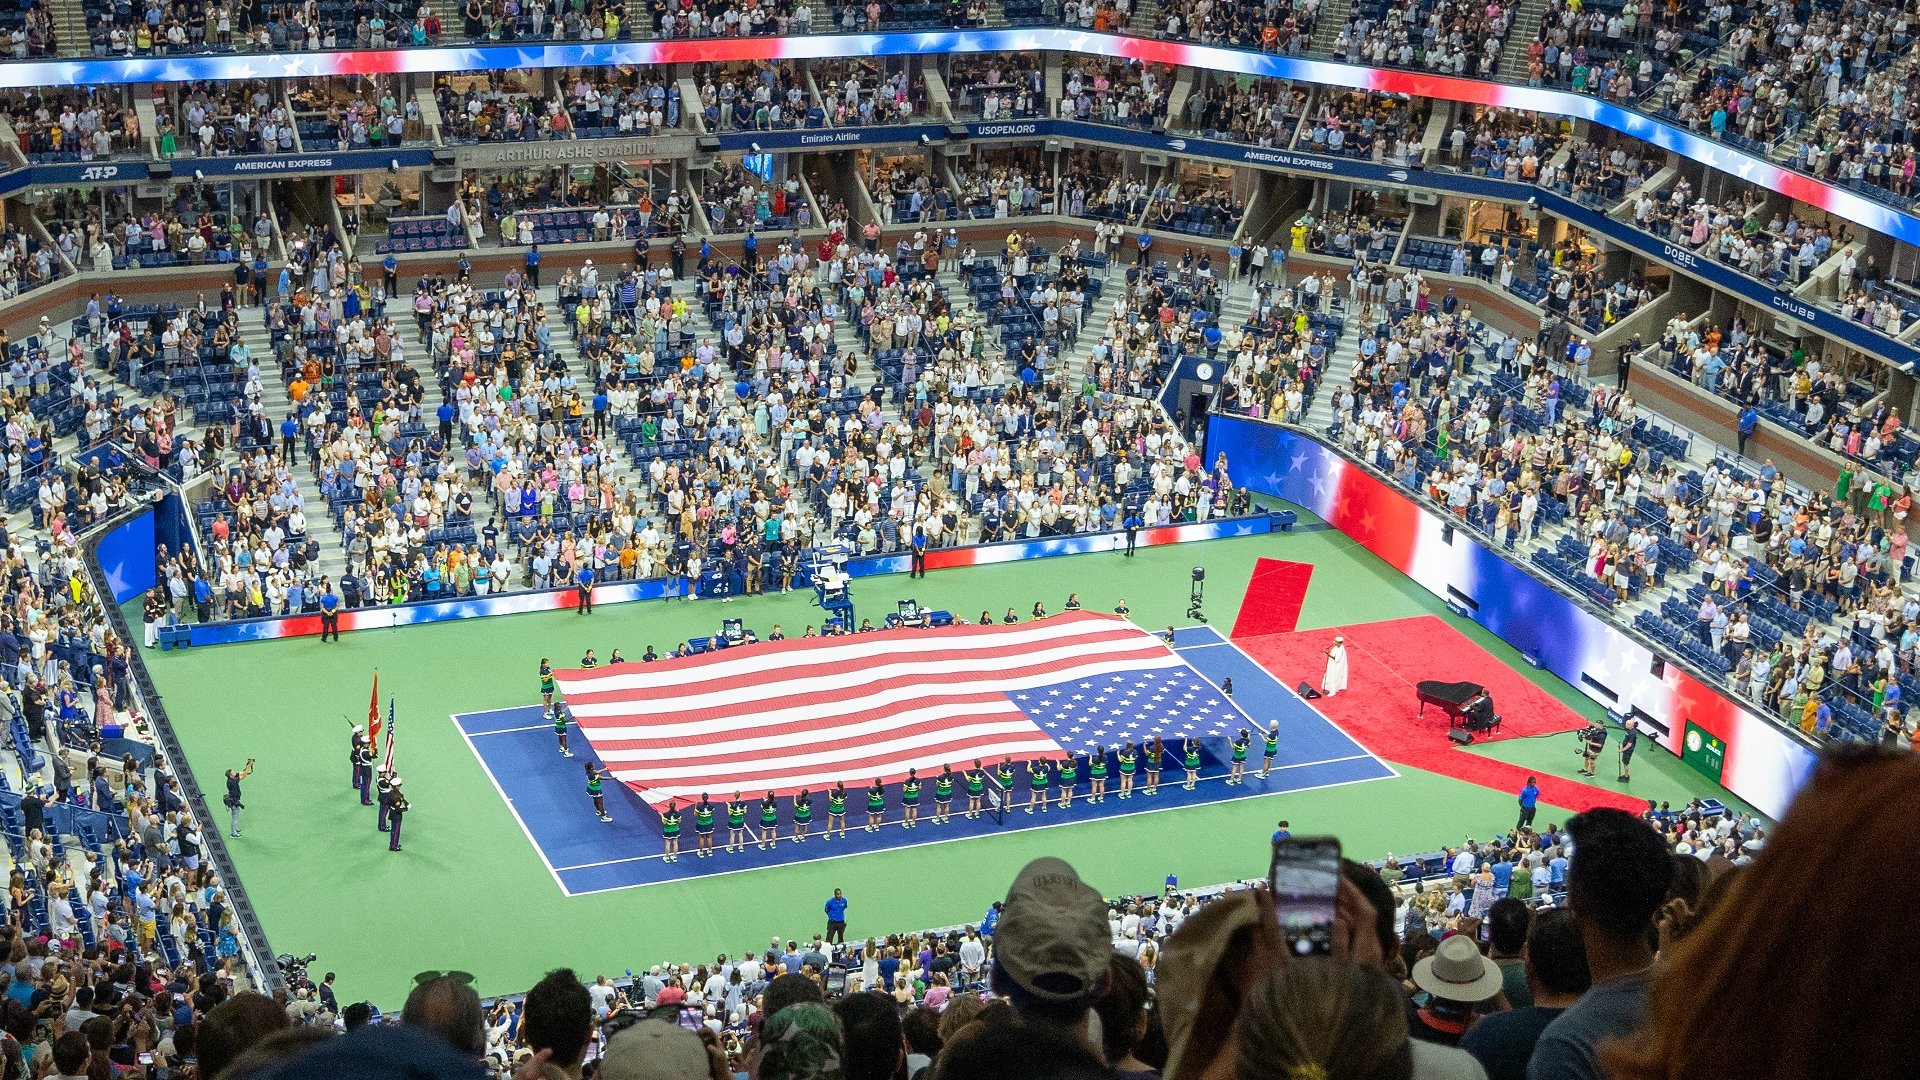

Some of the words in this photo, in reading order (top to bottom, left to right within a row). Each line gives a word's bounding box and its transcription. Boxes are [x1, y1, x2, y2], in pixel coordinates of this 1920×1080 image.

[978, 124, 1036, 135] USOPEN.ORG
[801, 133, 834, 143] Emirates
[496, 147, 552, 162] ARTHUR
[557, 145, 593, 159] ASHE
[599, 143, 656, 157] STADIUM
[1244, 151, 1291, 164] AMERICAN
[1292, 157, 1334, 170] EXPRESS
[234, 160, 285, 171] AMERICAN
[288, 158, 333, 168] EXPRESS
[81, 166, 118, 180] ATP
[1664, 245, 1699, 268] DOBEL
[1773, 296, 1815, 320] CHUBB
